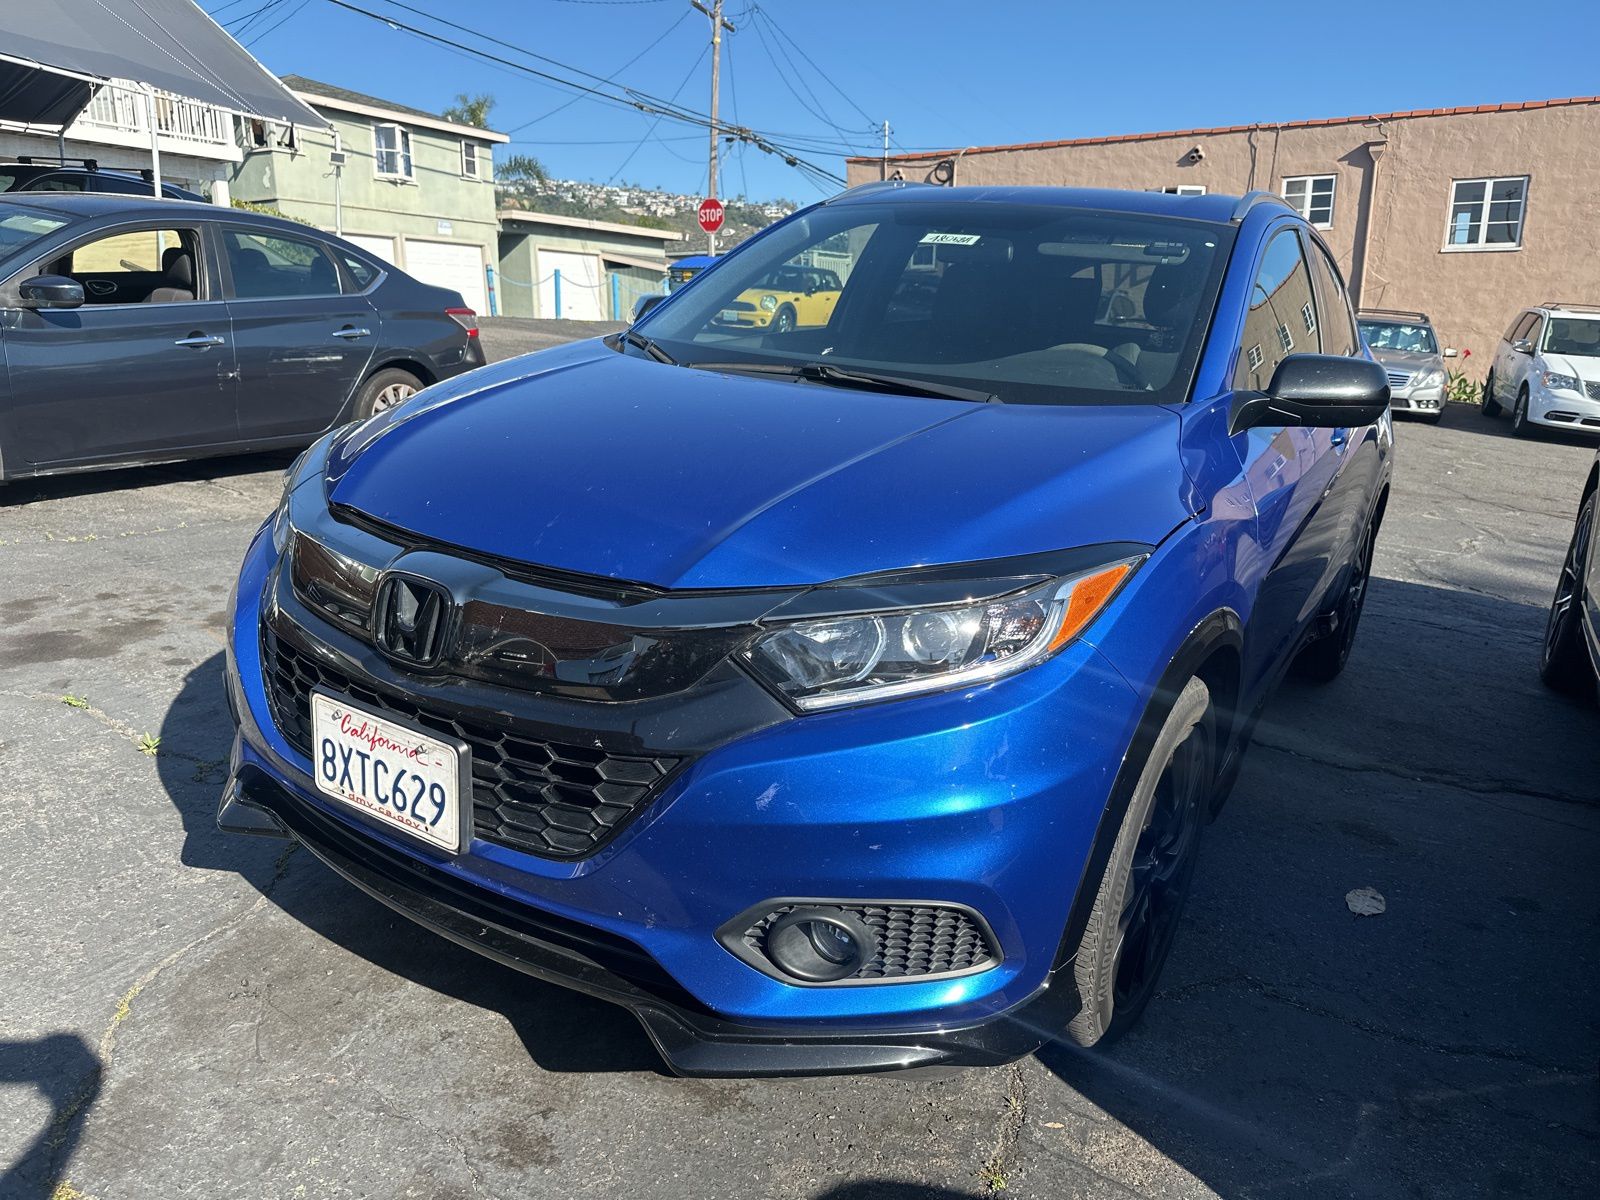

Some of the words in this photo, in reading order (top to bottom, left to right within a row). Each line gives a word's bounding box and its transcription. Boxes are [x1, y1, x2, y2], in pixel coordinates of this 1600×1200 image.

[700, 208, 722, 222] STOP
[341, 713, 428, 766] California
[322, 738, 446, 827] 8XTC629
[348, 792, 420, 829] dmv.ca.gov
